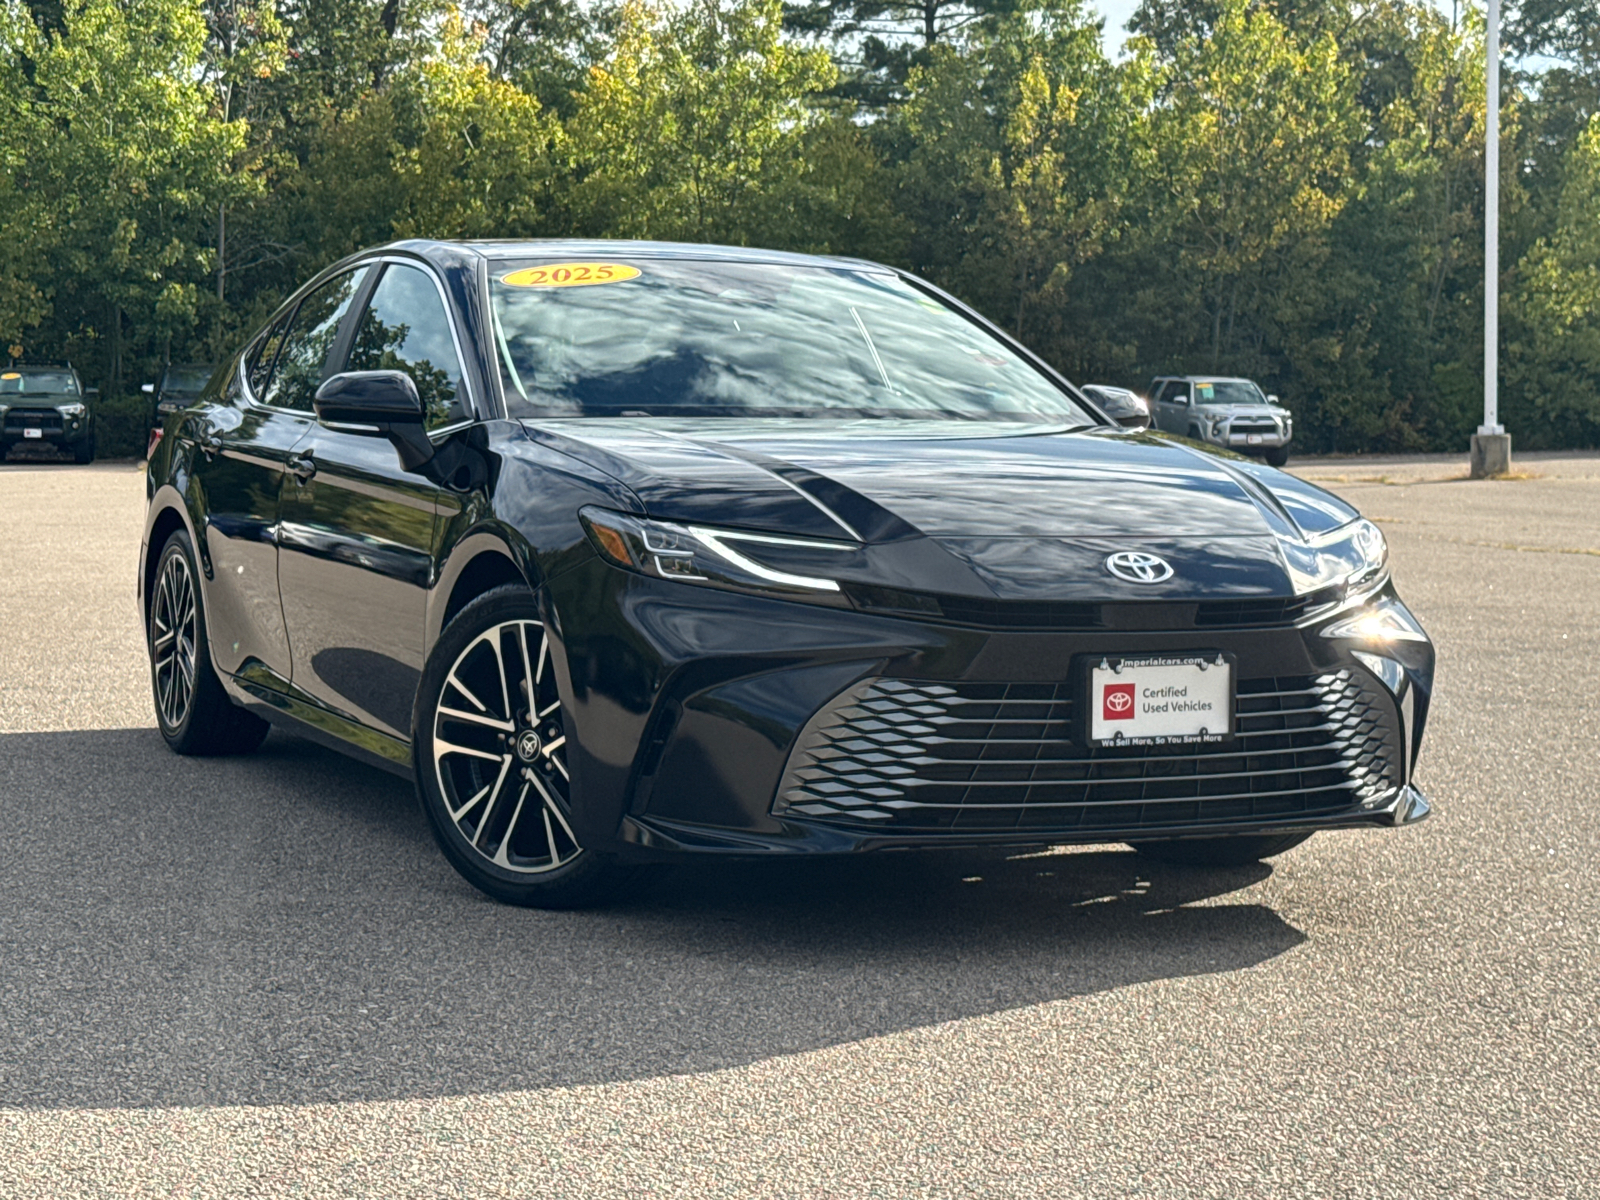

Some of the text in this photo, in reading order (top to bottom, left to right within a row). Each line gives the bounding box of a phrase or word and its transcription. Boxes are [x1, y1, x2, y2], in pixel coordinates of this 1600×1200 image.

[530, 266, 614, 284] 2025
[1120, 658, 1204, 668] Imperialcars.com
[1142, 686, 1188, 698] Certified
[1142, 700, 1212, 713] Used Vehicles
[1101, 739, 1115, 747] We
[1115, 738, 1130, 746] Sell
[1132, 737, 1154, 746] More,
[1155, 736, 1166, 744] So
[1183, 735, 1202, 743] Save
[1203, 734, 1222, 742] More
